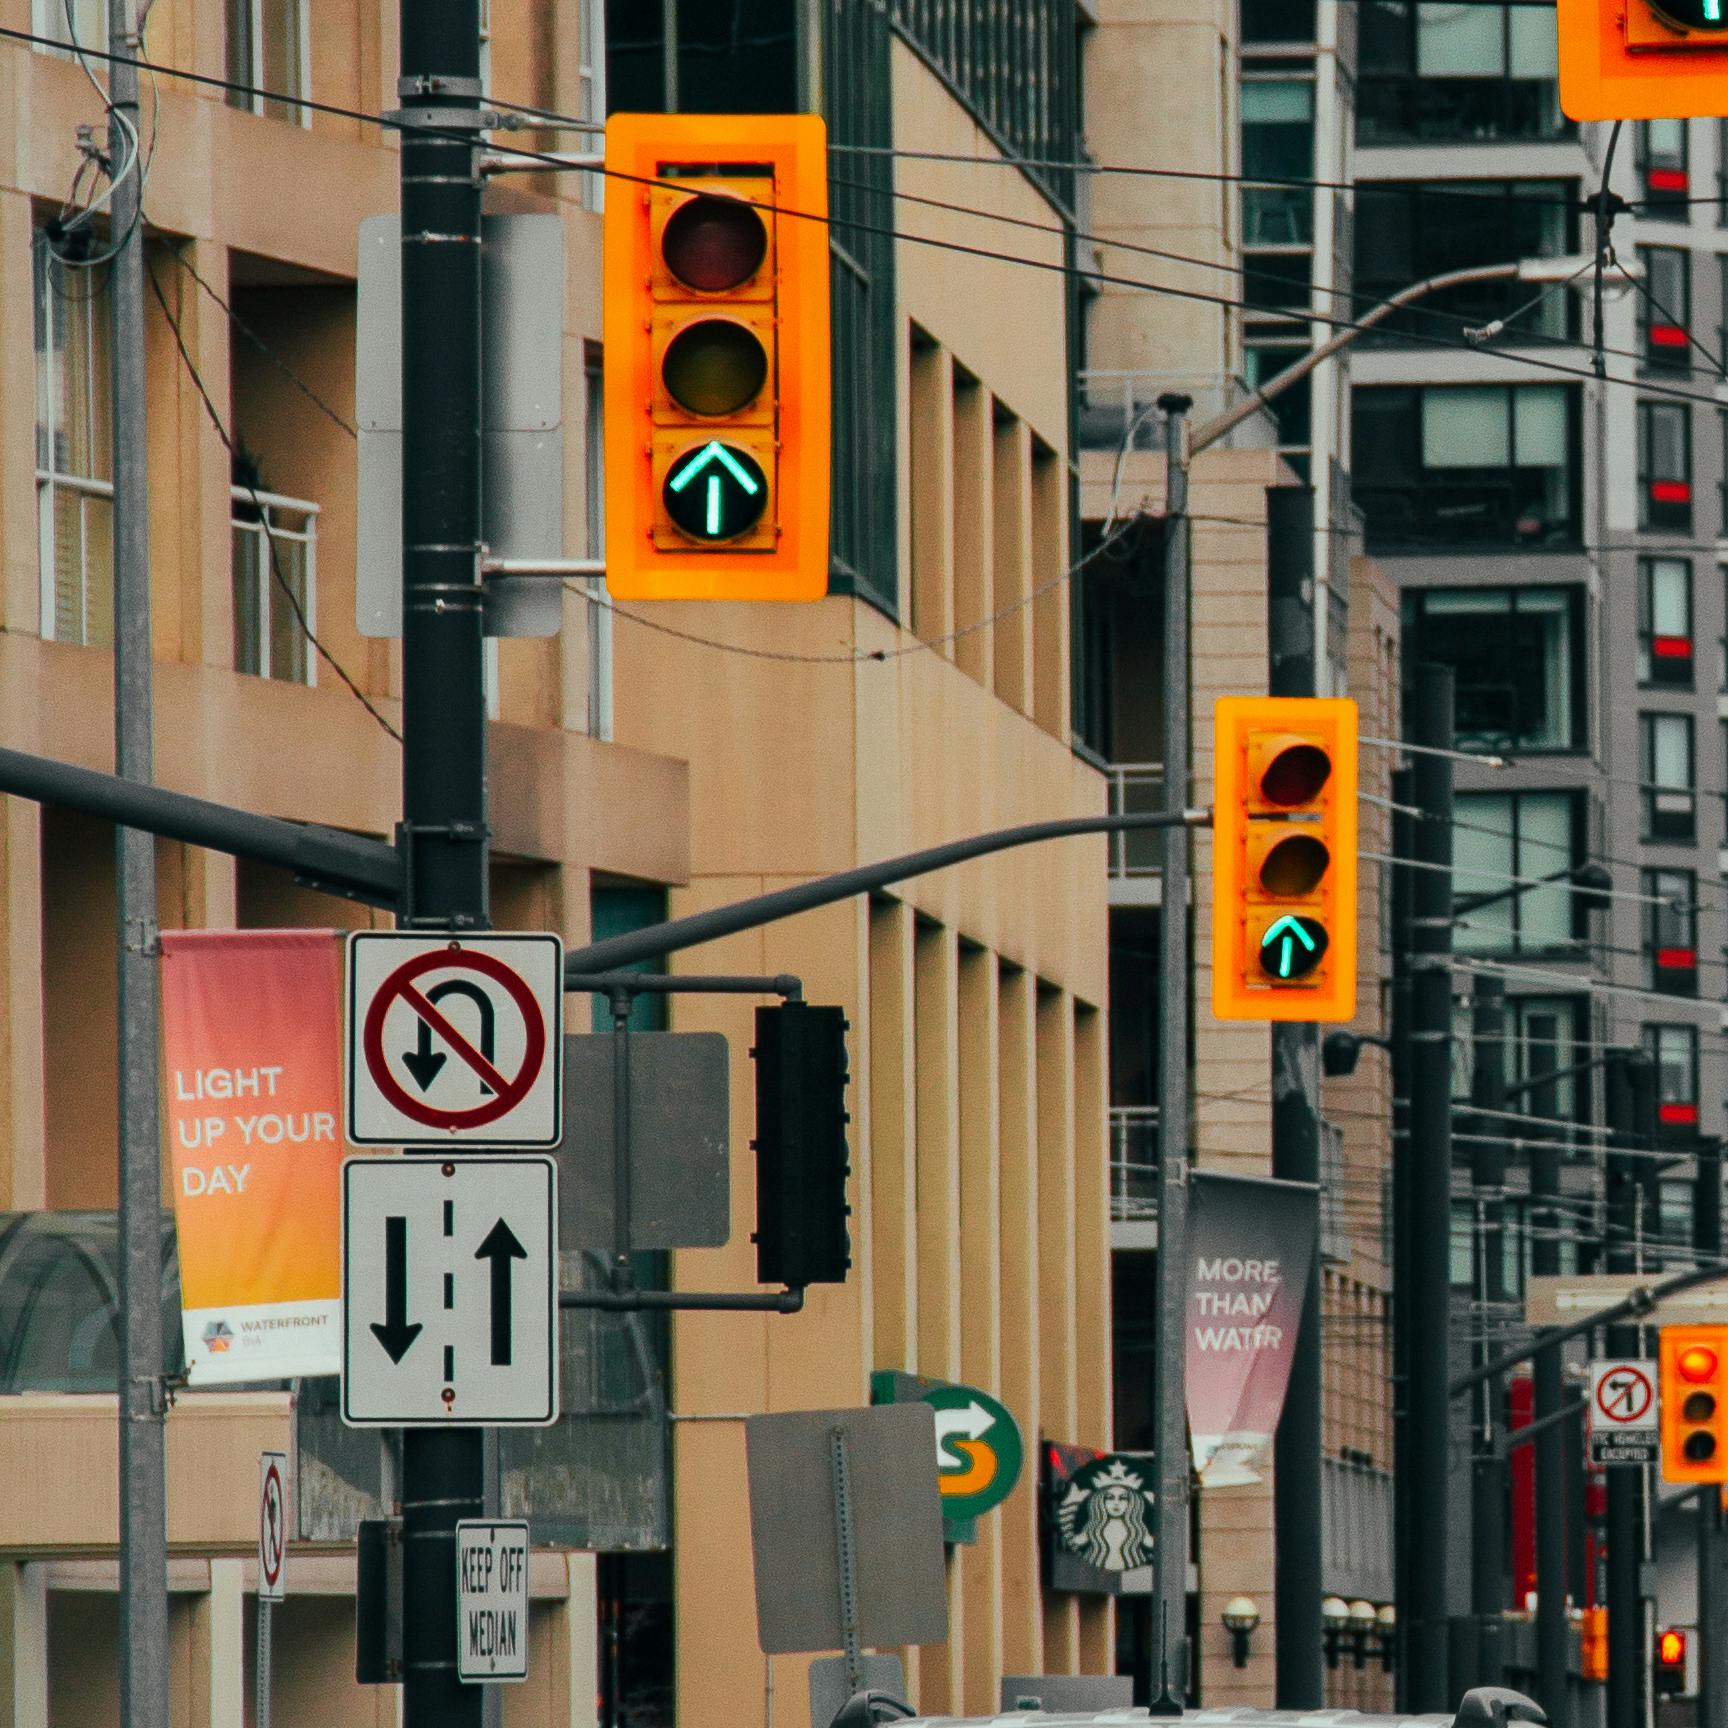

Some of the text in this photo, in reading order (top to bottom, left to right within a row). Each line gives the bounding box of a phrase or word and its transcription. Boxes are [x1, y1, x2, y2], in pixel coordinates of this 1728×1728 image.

[176, 1065, 284, 1101] LIGHT
[178, 1111, 336, 1149] UP YOUR
[182, 1163, 252, 1197] DAY
[1197, 1257, 1282, 1284] MORE
[1195, 1291, 1274, 1317] THAN
[240, 1315, 329, 1332] WATERFRONT
[461, 1546, 524, 1594] KEEP OFF
[468, 1610, 517, 1657] MEDIAN
